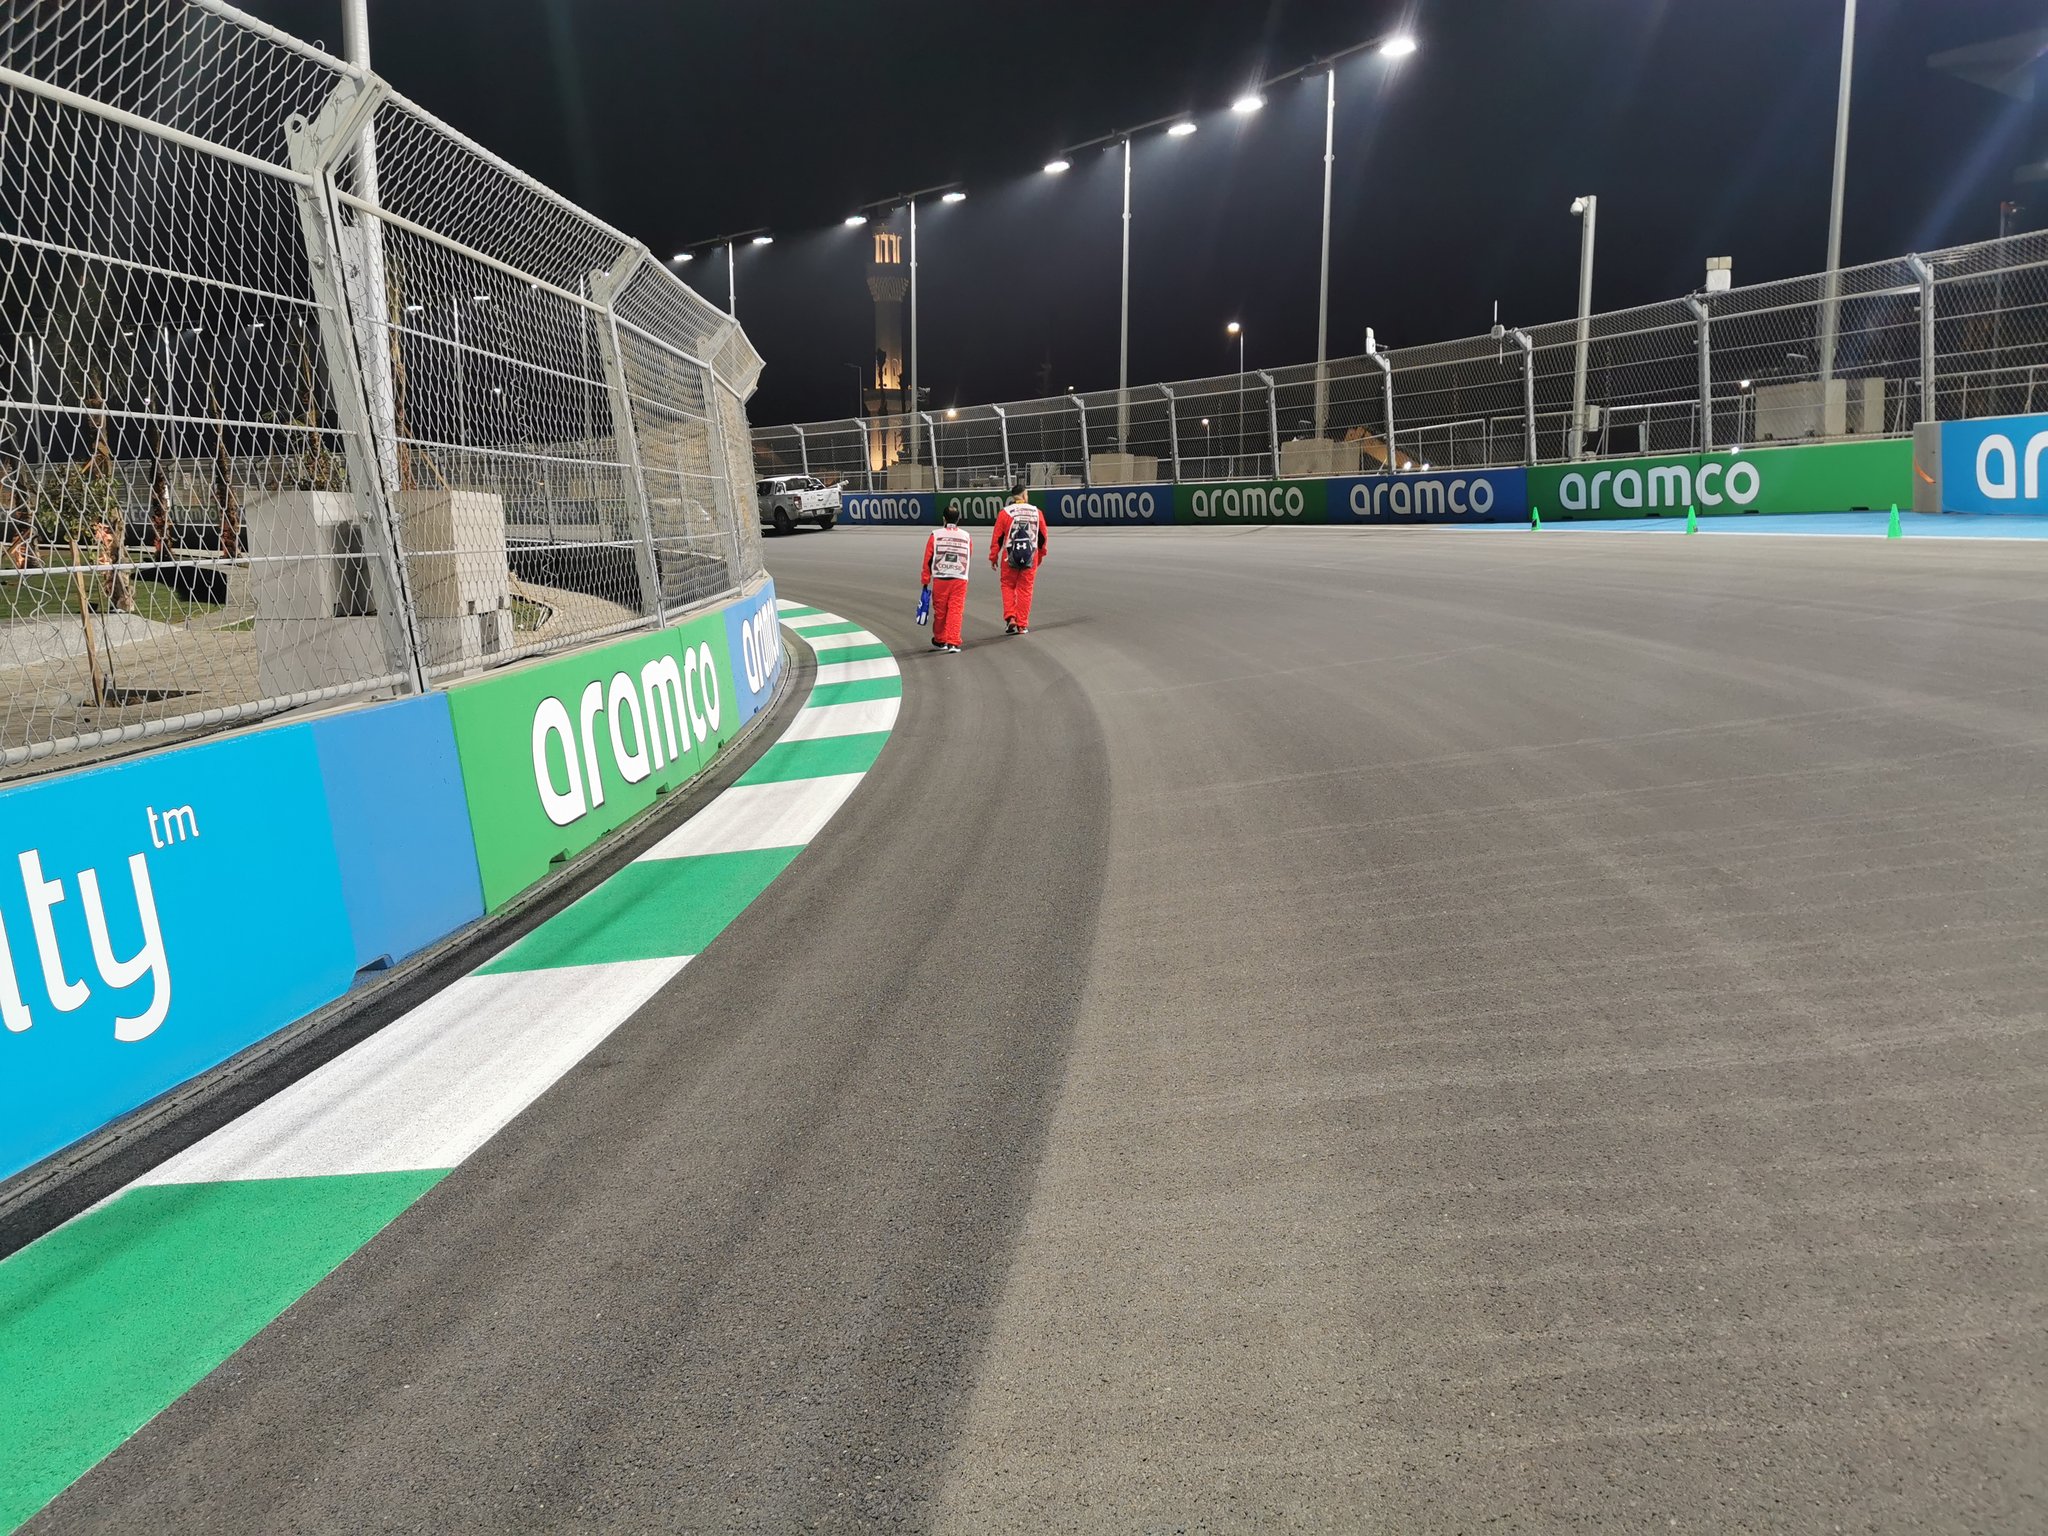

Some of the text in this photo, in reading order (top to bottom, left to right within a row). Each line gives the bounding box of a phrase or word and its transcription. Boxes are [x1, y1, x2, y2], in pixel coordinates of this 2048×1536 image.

[1192, 486, 1304, 517] aramco
[1350, 478, 1494, 515] aramco
[1559, 460, 1760, 510] aramco
[849, 498, 921, 520] aramco
[1060, 491, 1155, 520] aramco
[532, 641, 720, 826] aramco
[146, 804, 199, 849] tm
